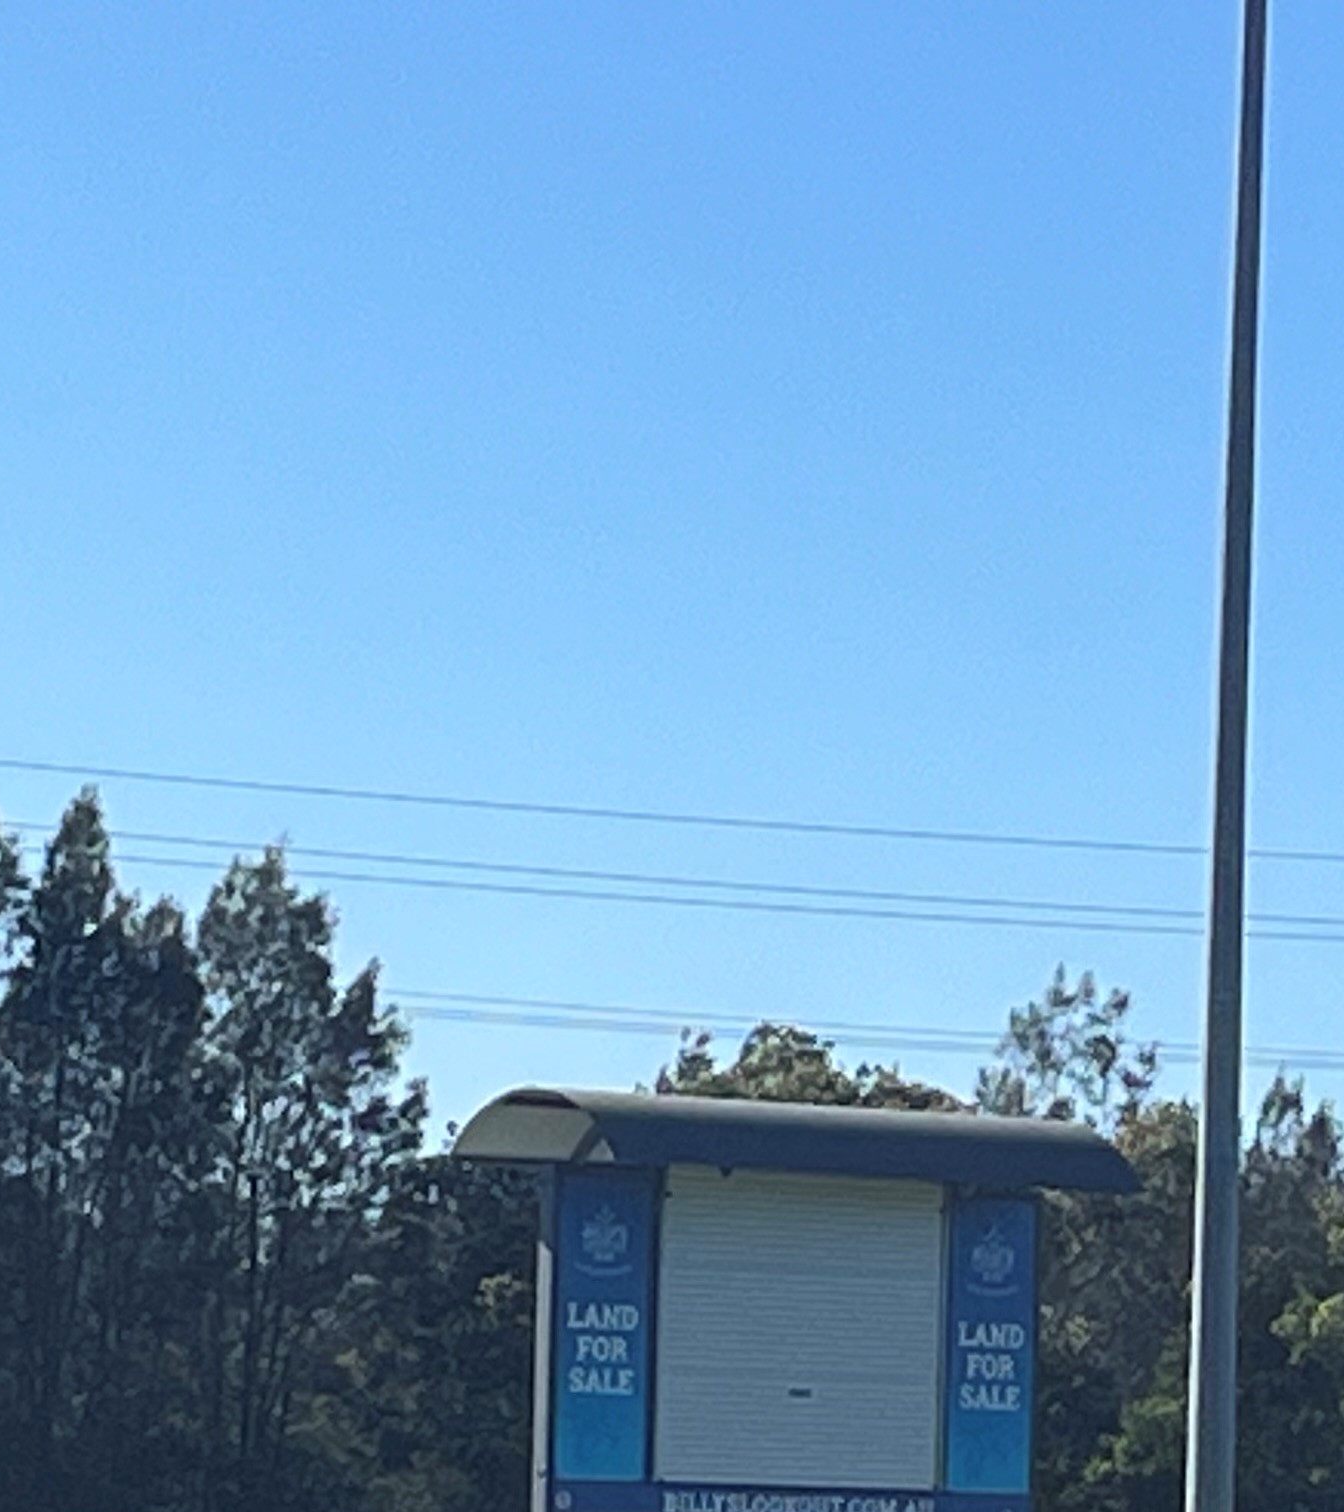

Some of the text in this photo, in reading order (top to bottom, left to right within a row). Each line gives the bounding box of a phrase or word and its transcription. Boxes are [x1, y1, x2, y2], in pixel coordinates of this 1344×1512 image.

[567, 1302, 639, 1331] LAND
[958, 1321, 1024, 1348] LAND
[576, 1336, 627, 1362] FOR
[967, 1354, 1015, 1380] FOR
[569, 1367, 635, 1396] SALE
[960, 1383, 1021, 1411] SALE
